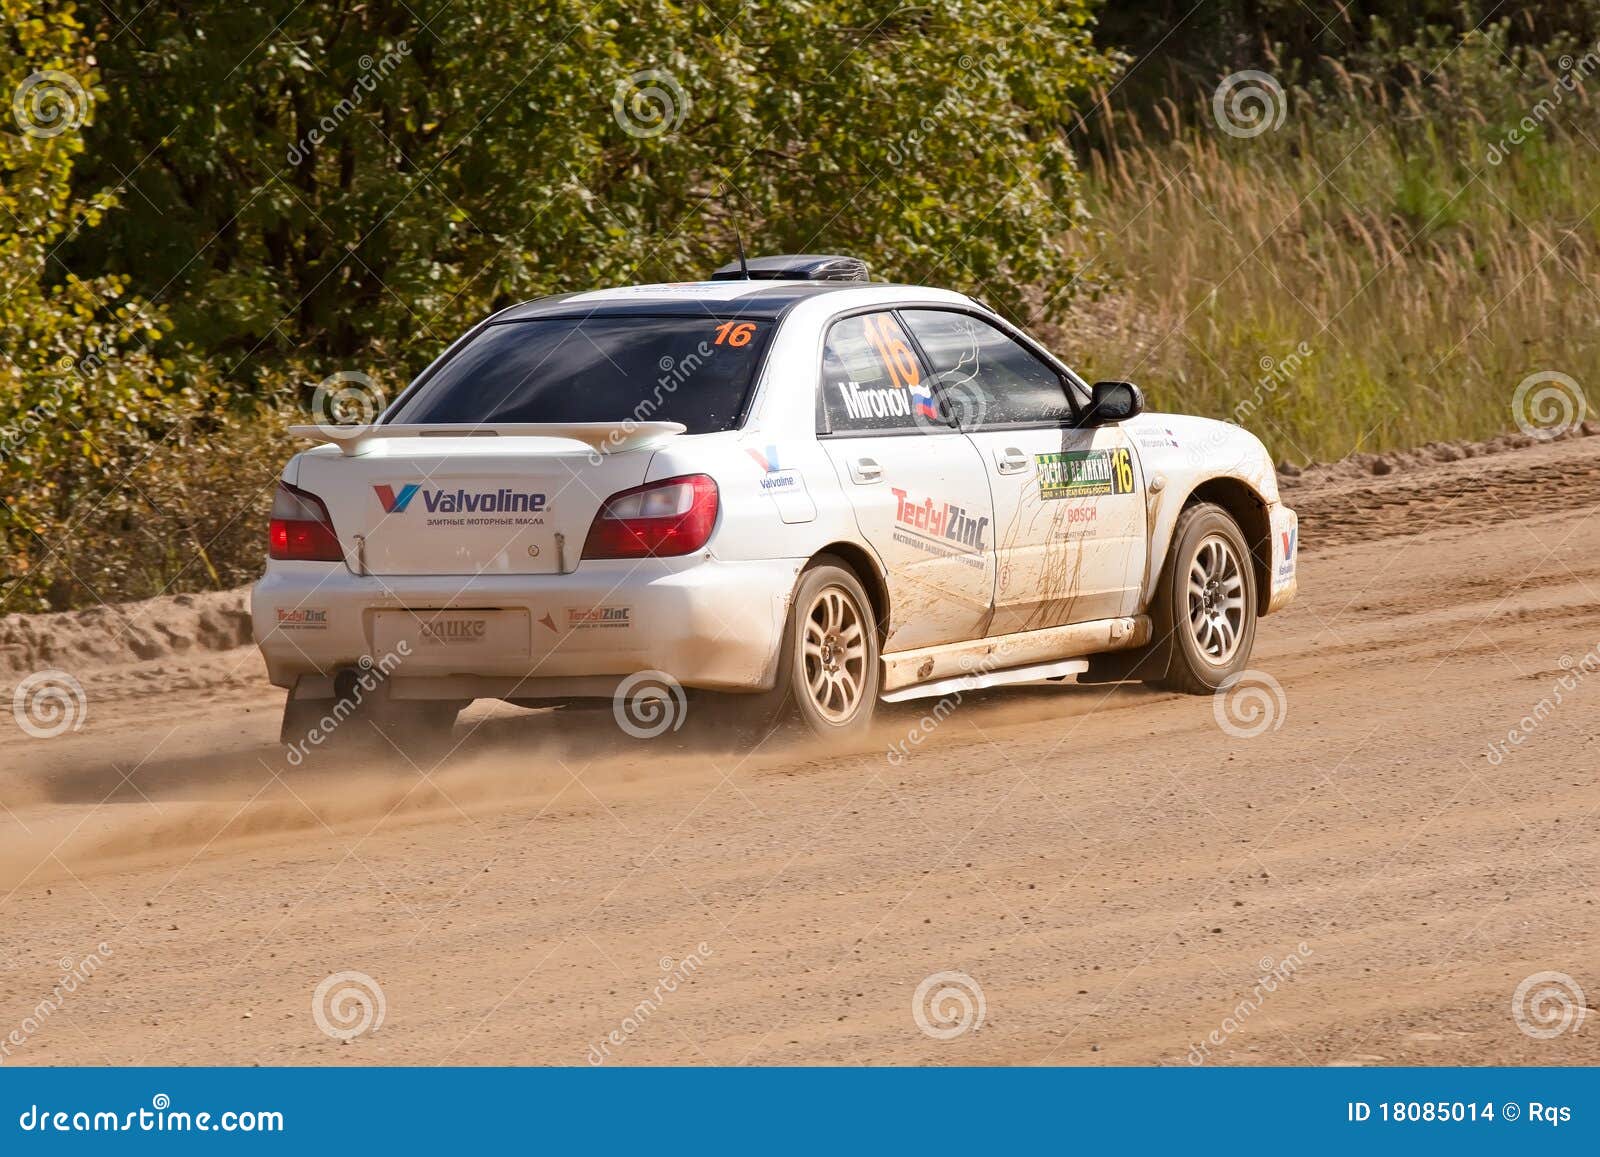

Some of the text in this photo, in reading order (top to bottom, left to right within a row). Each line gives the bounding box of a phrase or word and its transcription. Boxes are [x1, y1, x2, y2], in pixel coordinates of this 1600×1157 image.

[713, 320, 757, 347] 16
[863, 312, 920, 388] 16
[838, 381, 911, 419] Mironov
[760, 476, 794, 489] Valvoline
[1112, 448, 1133, 493] 16
[422, 489, 547, 513] Valvoline
[466, 518, 513, 526] МОТОРНЫЕ
[1068, 507, 1097, 522] BOSCH
